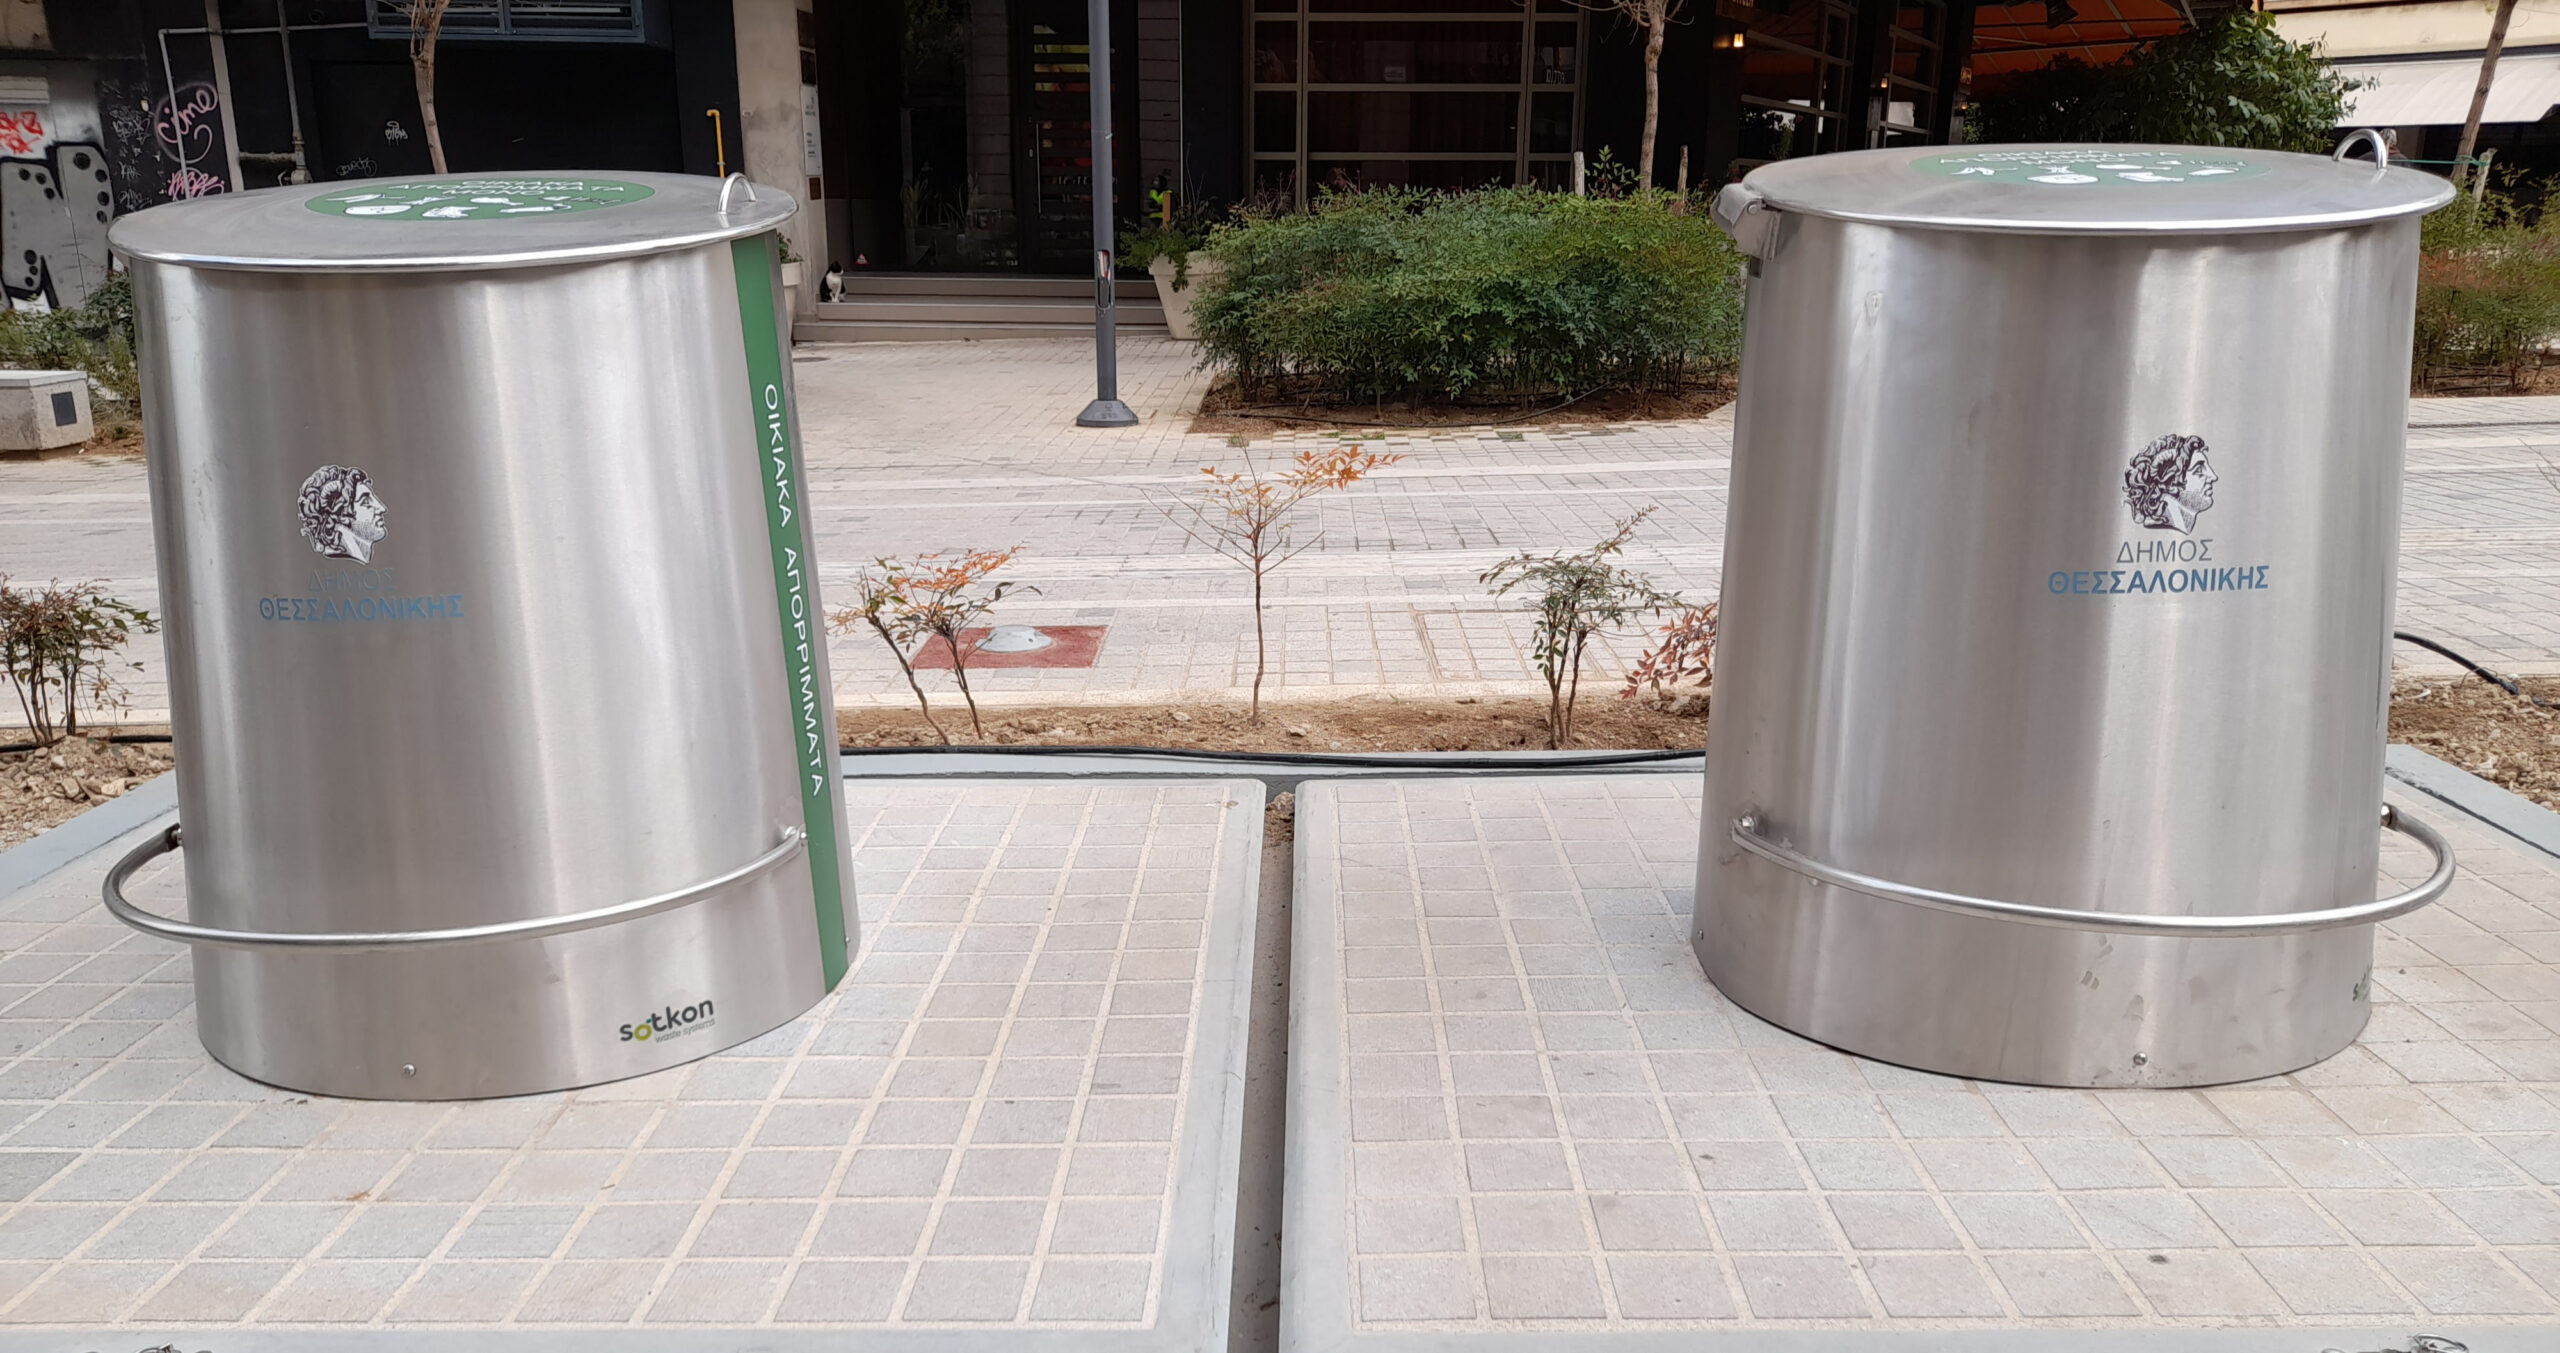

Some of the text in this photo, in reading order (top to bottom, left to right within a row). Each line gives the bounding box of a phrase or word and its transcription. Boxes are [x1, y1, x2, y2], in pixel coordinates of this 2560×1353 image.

[2116, 538, 2214, 563] ΔΗΜΟΣ
[308, 567, 398, 592] ΔΗΜΟΣ
[764, 383, 824, 797] ΟΙΚΙΑΚΑ ΑΠΟΡΡΙΜΜΑΤΑ
[2047, 565, 2270, 595] ΘΕΣΣΑΛΟΝΙΚΗΣ
[259, 595, 466, 621] ΘΕΣΣΑΛΟΝΙΚΗΣ
[619, 1000, 714, 1042] sotkon
